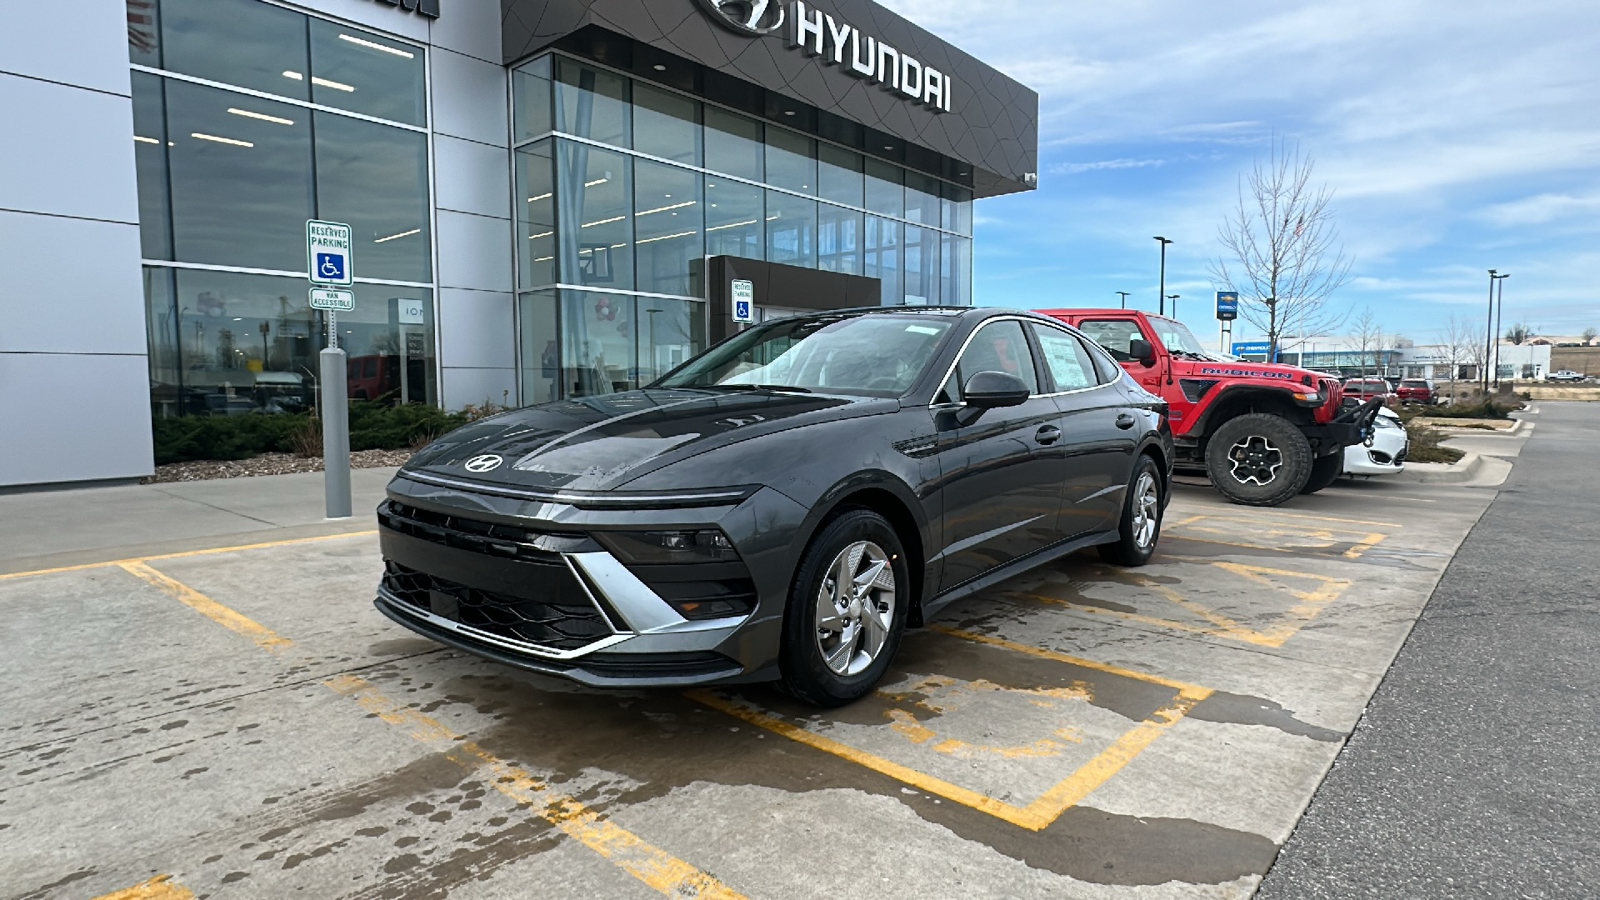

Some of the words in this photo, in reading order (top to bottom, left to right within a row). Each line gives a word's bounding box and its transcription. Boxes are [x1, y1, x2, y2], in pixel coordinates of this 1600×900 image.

[797, 0, 950, 112] HYUNDAI
[311, 226, 347, 238] RESERVED
[311, 237, 348, 249] PARKING
[314, 298, 350, 307] ACCESSIBLE
[1201, 367, 1293, 379] RUBICON
